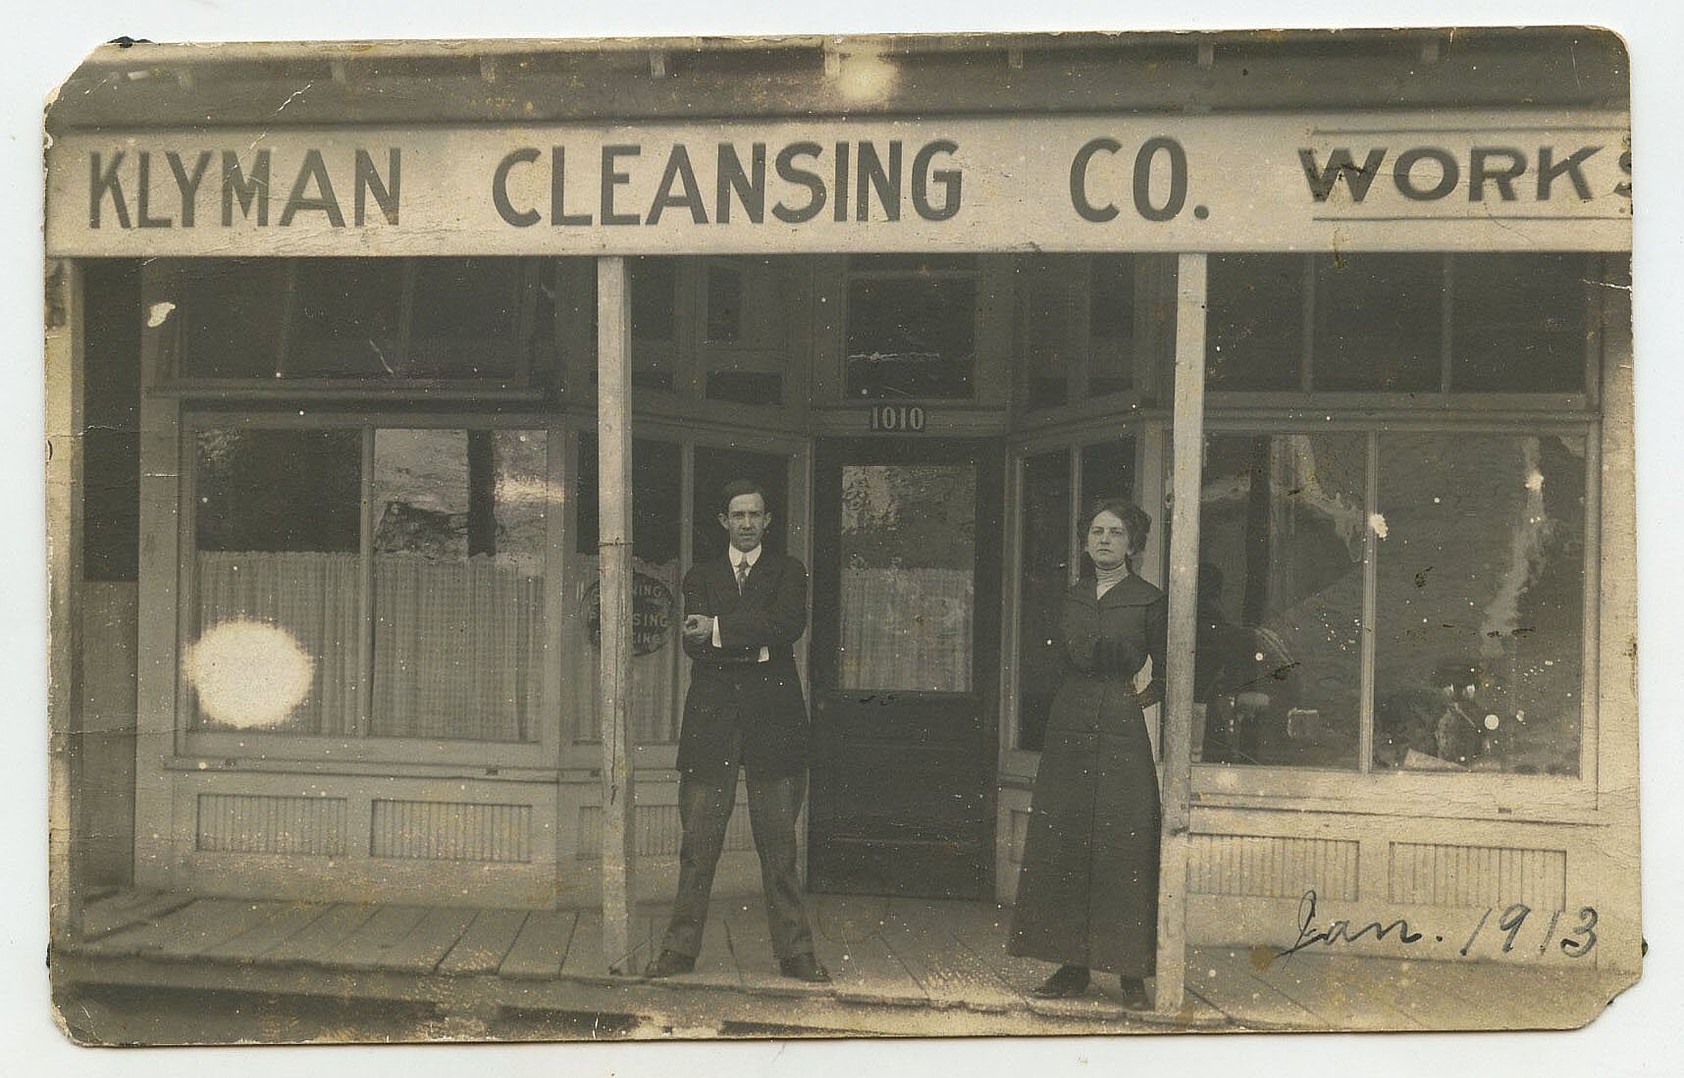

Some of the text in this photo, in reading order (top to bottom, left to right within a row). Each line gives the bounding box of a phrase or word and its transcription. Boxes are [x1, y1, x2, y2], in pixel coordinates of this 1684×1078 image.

[89, 147, 401, 229] KLYMAN
[492, 139, 962, 226] CLEANSING
[1069, 136, 1209, 222] CO.
[872, 406, 924, 430] 1010
[1274, 889, 1598, 962] Jan. 1913
